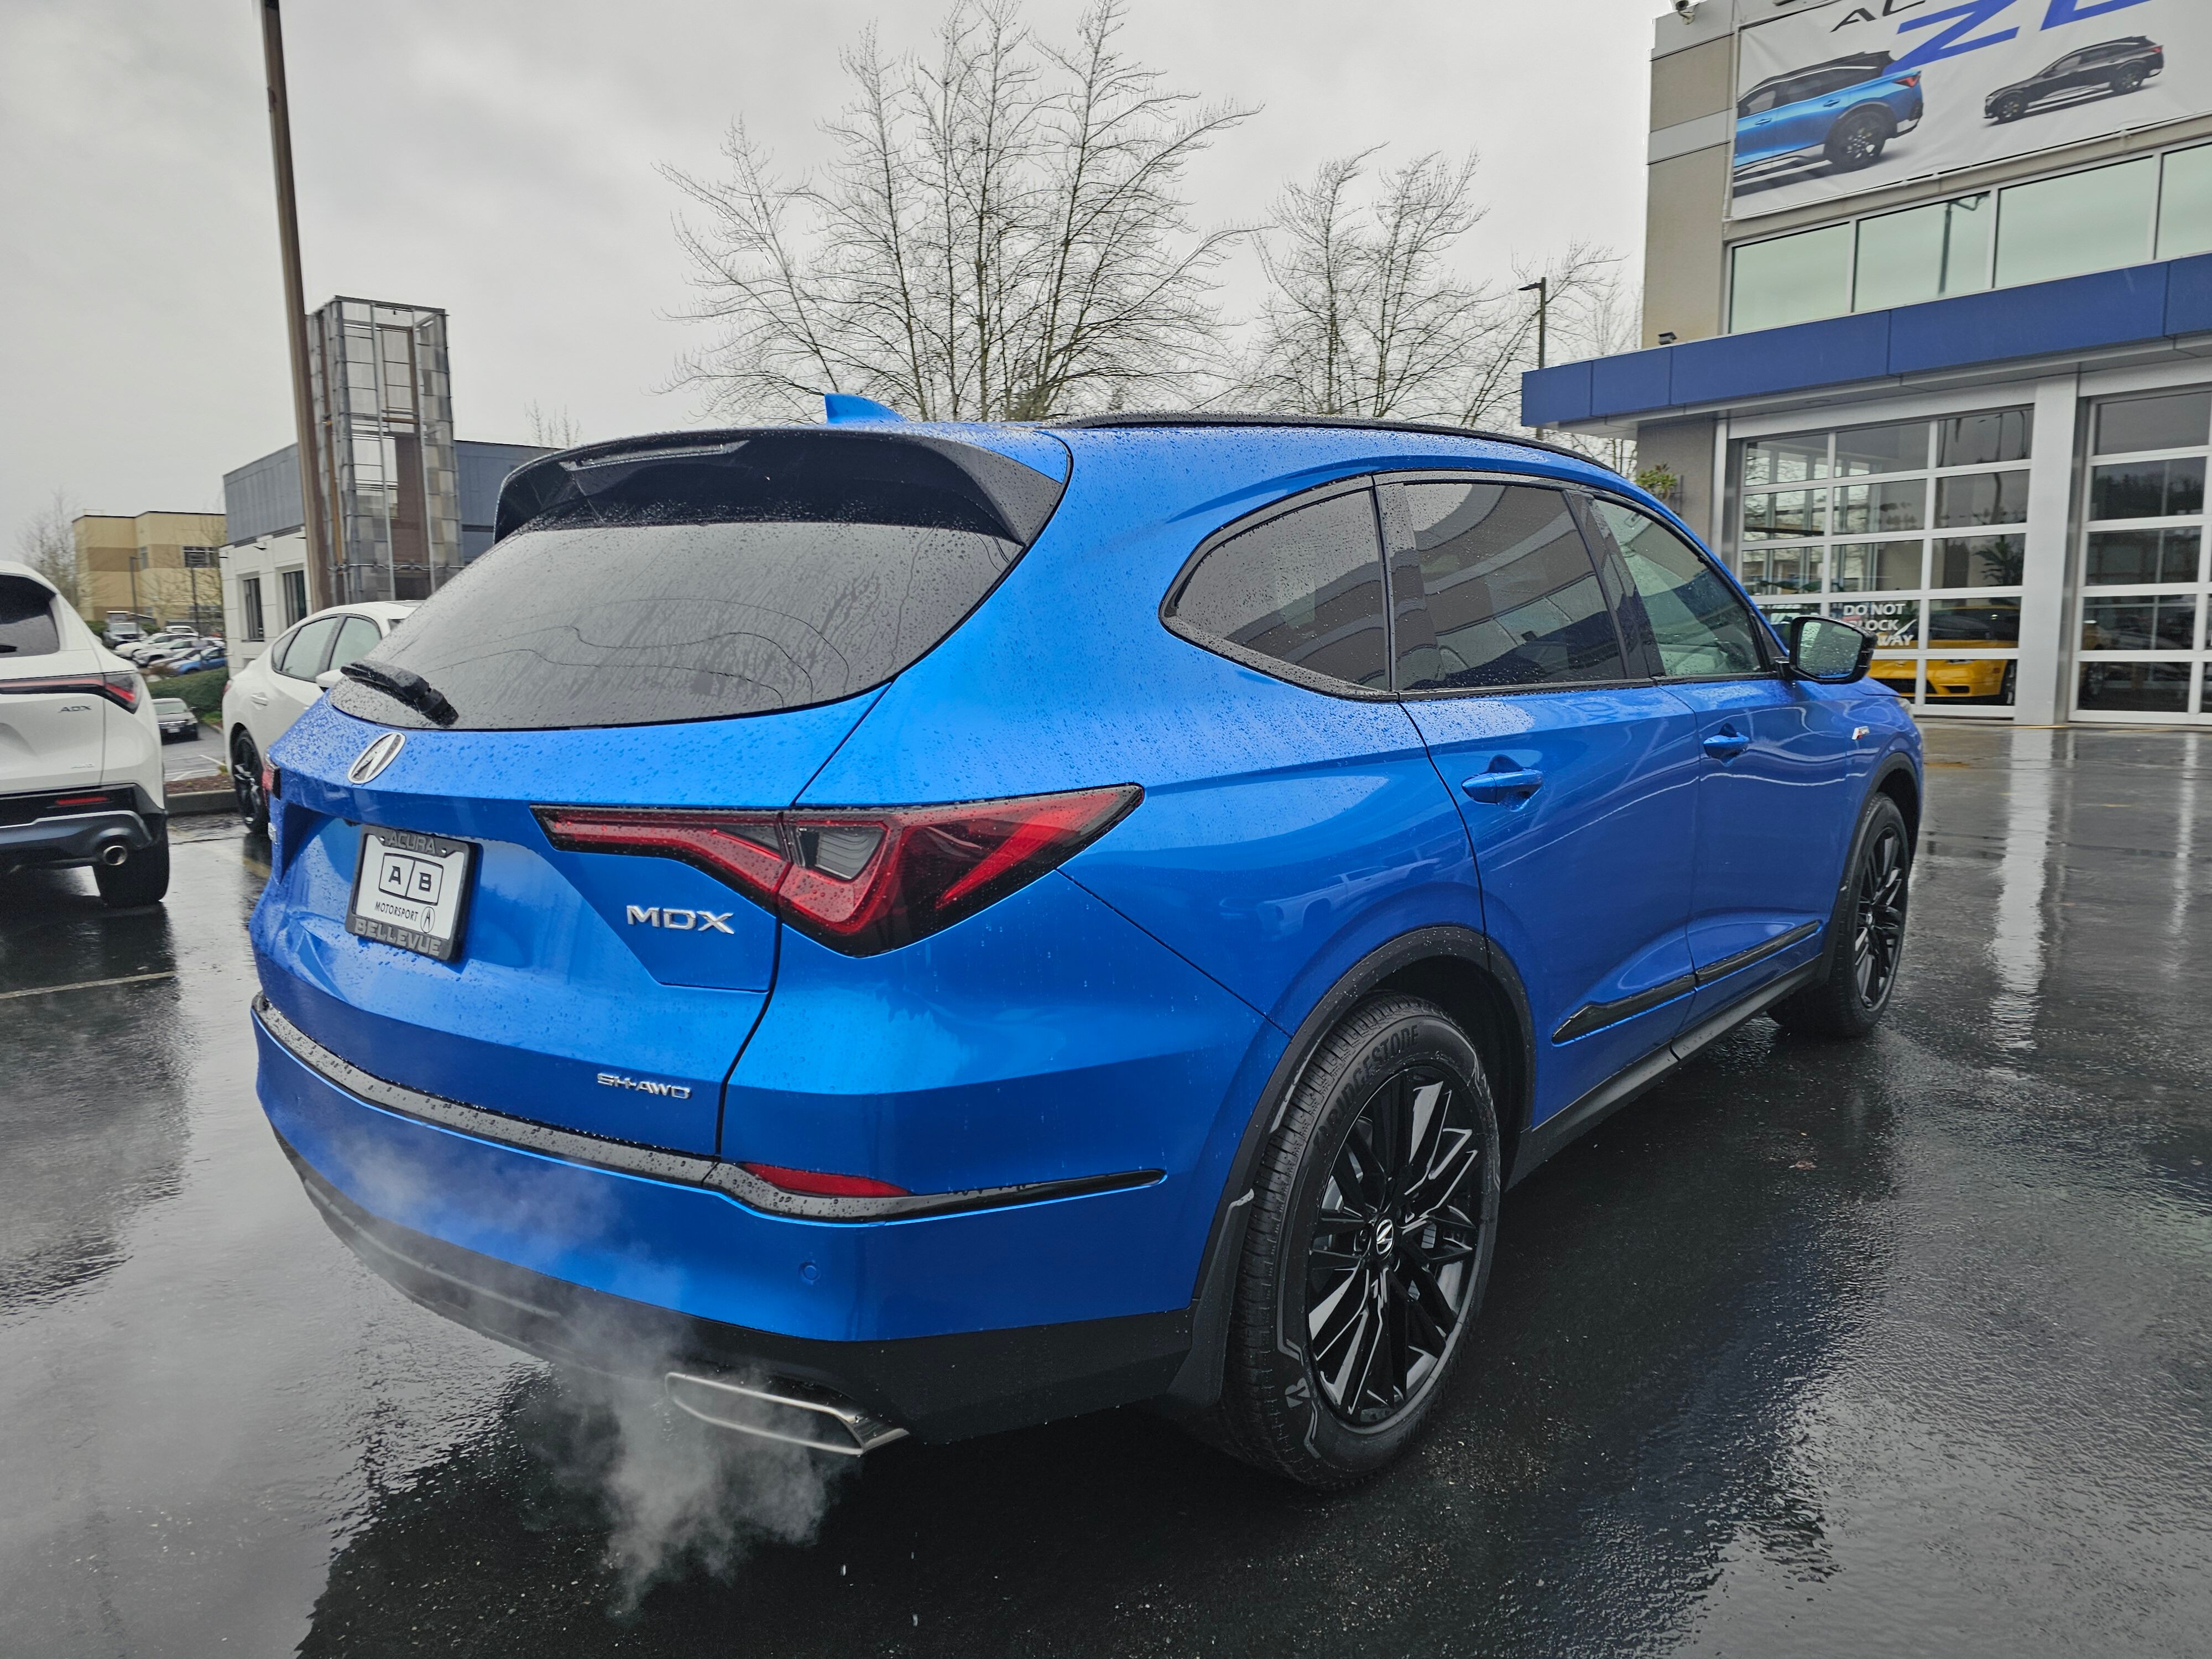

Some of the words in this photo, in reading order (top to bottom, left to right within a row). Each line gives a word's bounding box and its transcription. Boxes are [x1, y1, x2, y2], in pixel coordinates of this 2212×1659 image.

[1843, 604, 1868, 616] DO
[1870, 603, 1907, 615] NOT
[57, 705, 92, 713] ADX
[387, 831, 436, 854] ACURA
[388, 865, 401, 885] A
[419, 872, 432, 892] B
[374, 901, 419, 922] MOTORSPORT
[626, 905, 734, 935] MDX
[354, 917, 442, 956] BELLEVUE
[597, 1072, 691, 1100] SH-AWD
